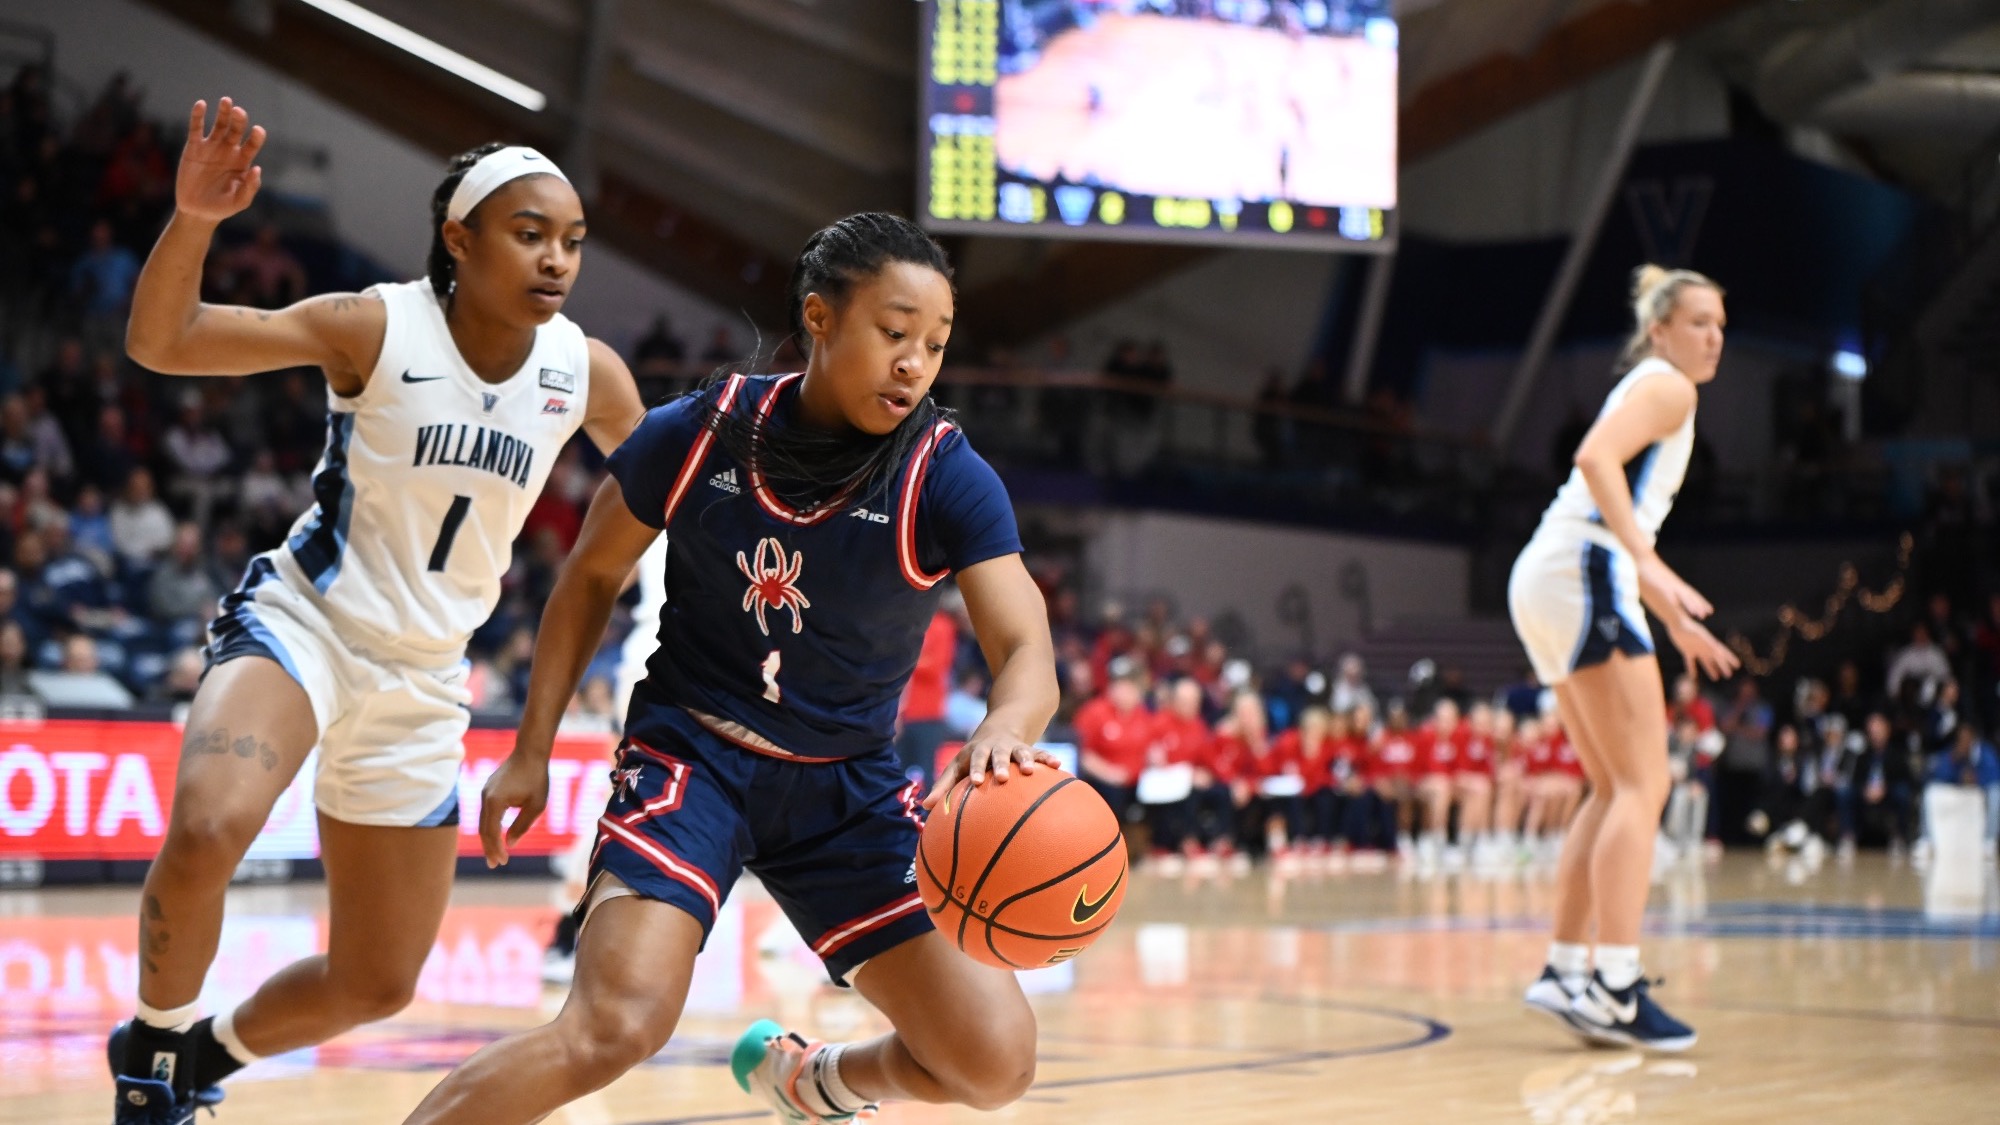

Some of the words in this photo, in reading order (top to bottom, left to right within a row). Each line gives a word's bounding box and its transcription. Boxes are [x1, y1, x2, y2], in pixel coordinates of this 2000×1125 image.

[413, 424, 534, 489] VILLANOVA
[709, 477, 741, 495] adidas
[427, 494, 472, 573] 1
[760, 650, 781, 704] 1
